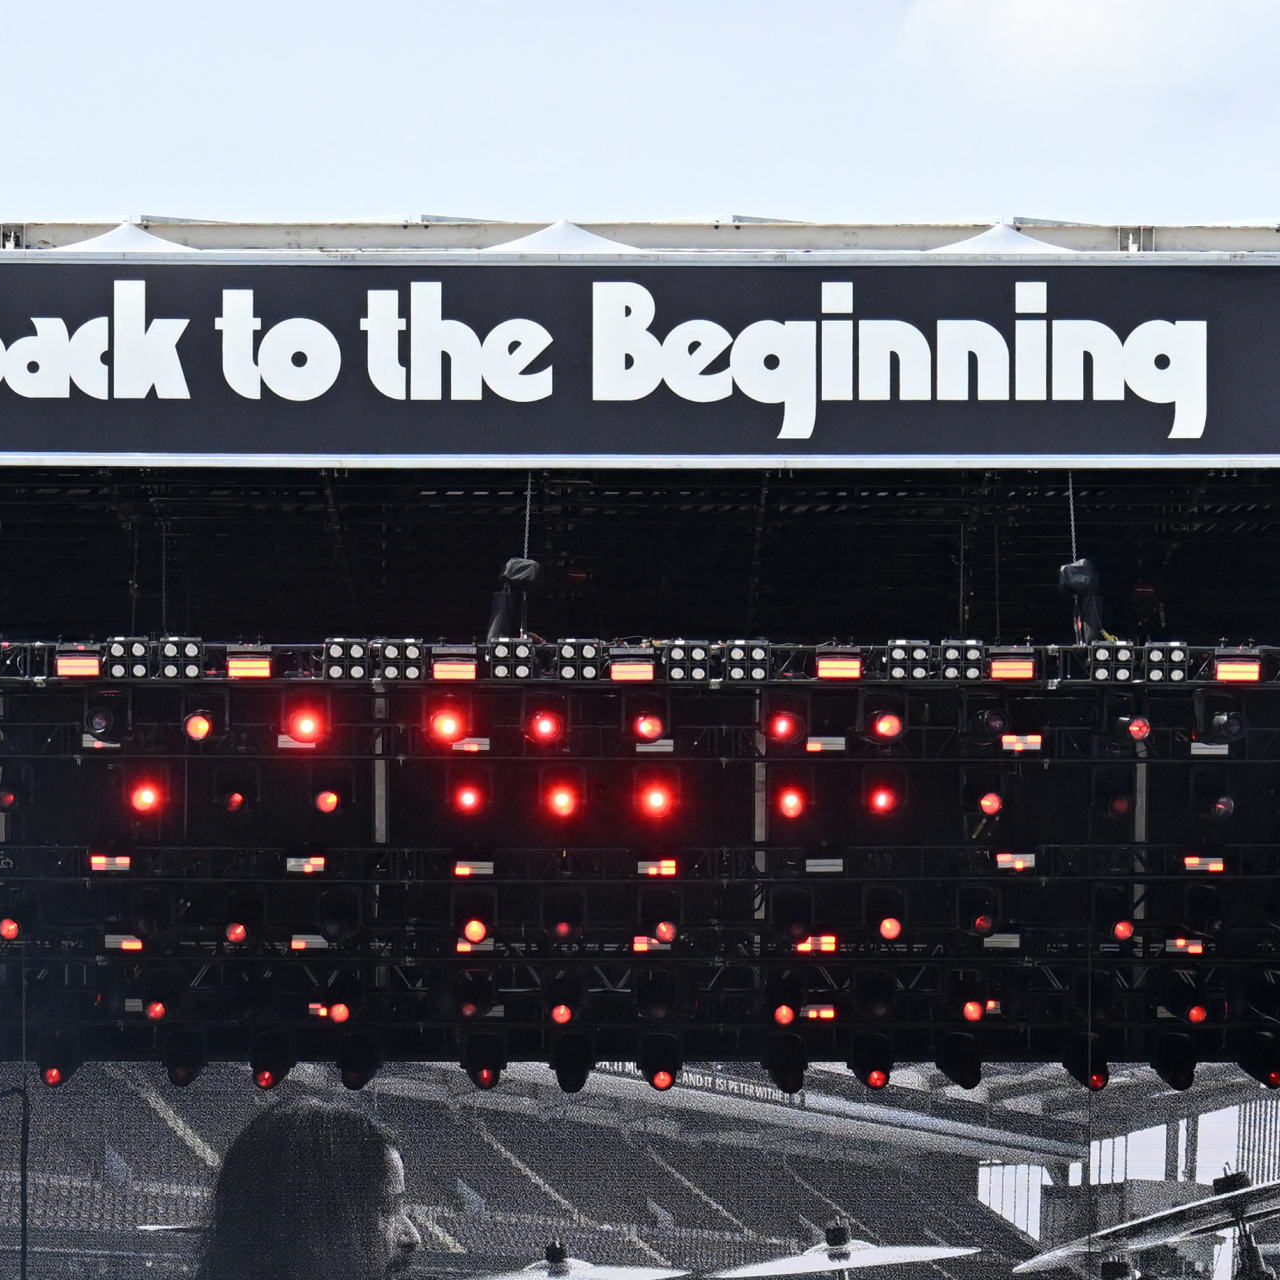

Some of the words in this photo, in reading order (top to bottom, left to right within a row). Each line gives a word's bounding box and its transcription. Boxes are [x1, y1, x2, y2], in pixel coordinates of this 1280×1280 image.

[214, 289, 342, 402] to
[359, 281, 554, 403] the
[592, 281, 1208, 439] Beginning
[728, 1080, 755, 1097] PETER
